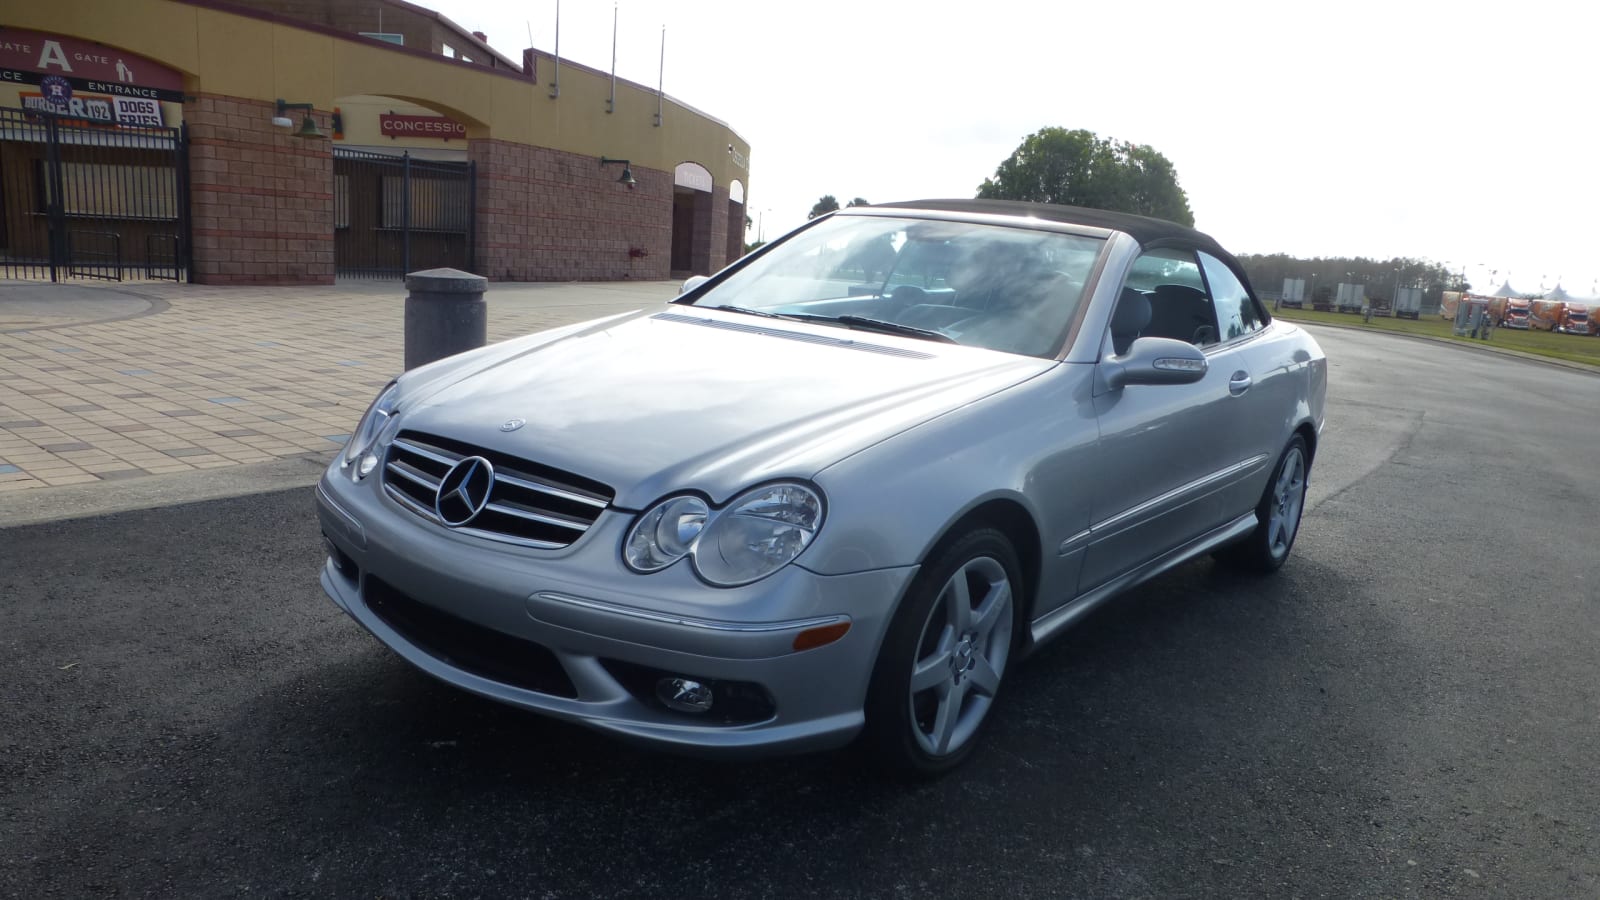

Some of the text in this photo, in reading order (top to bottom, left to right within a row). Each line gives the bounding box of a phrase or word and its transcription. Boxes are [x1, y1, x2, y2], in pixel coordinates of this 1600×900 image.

[37, 39, 73, 72] A
[74, 53, 109, 64] GATE
[0, 71, 22, 81] CE
[88, 81, 158, 98] ENTRANCE
[91, 106, 109, 119] 192
[119, 100, 154, 114] DOGS
